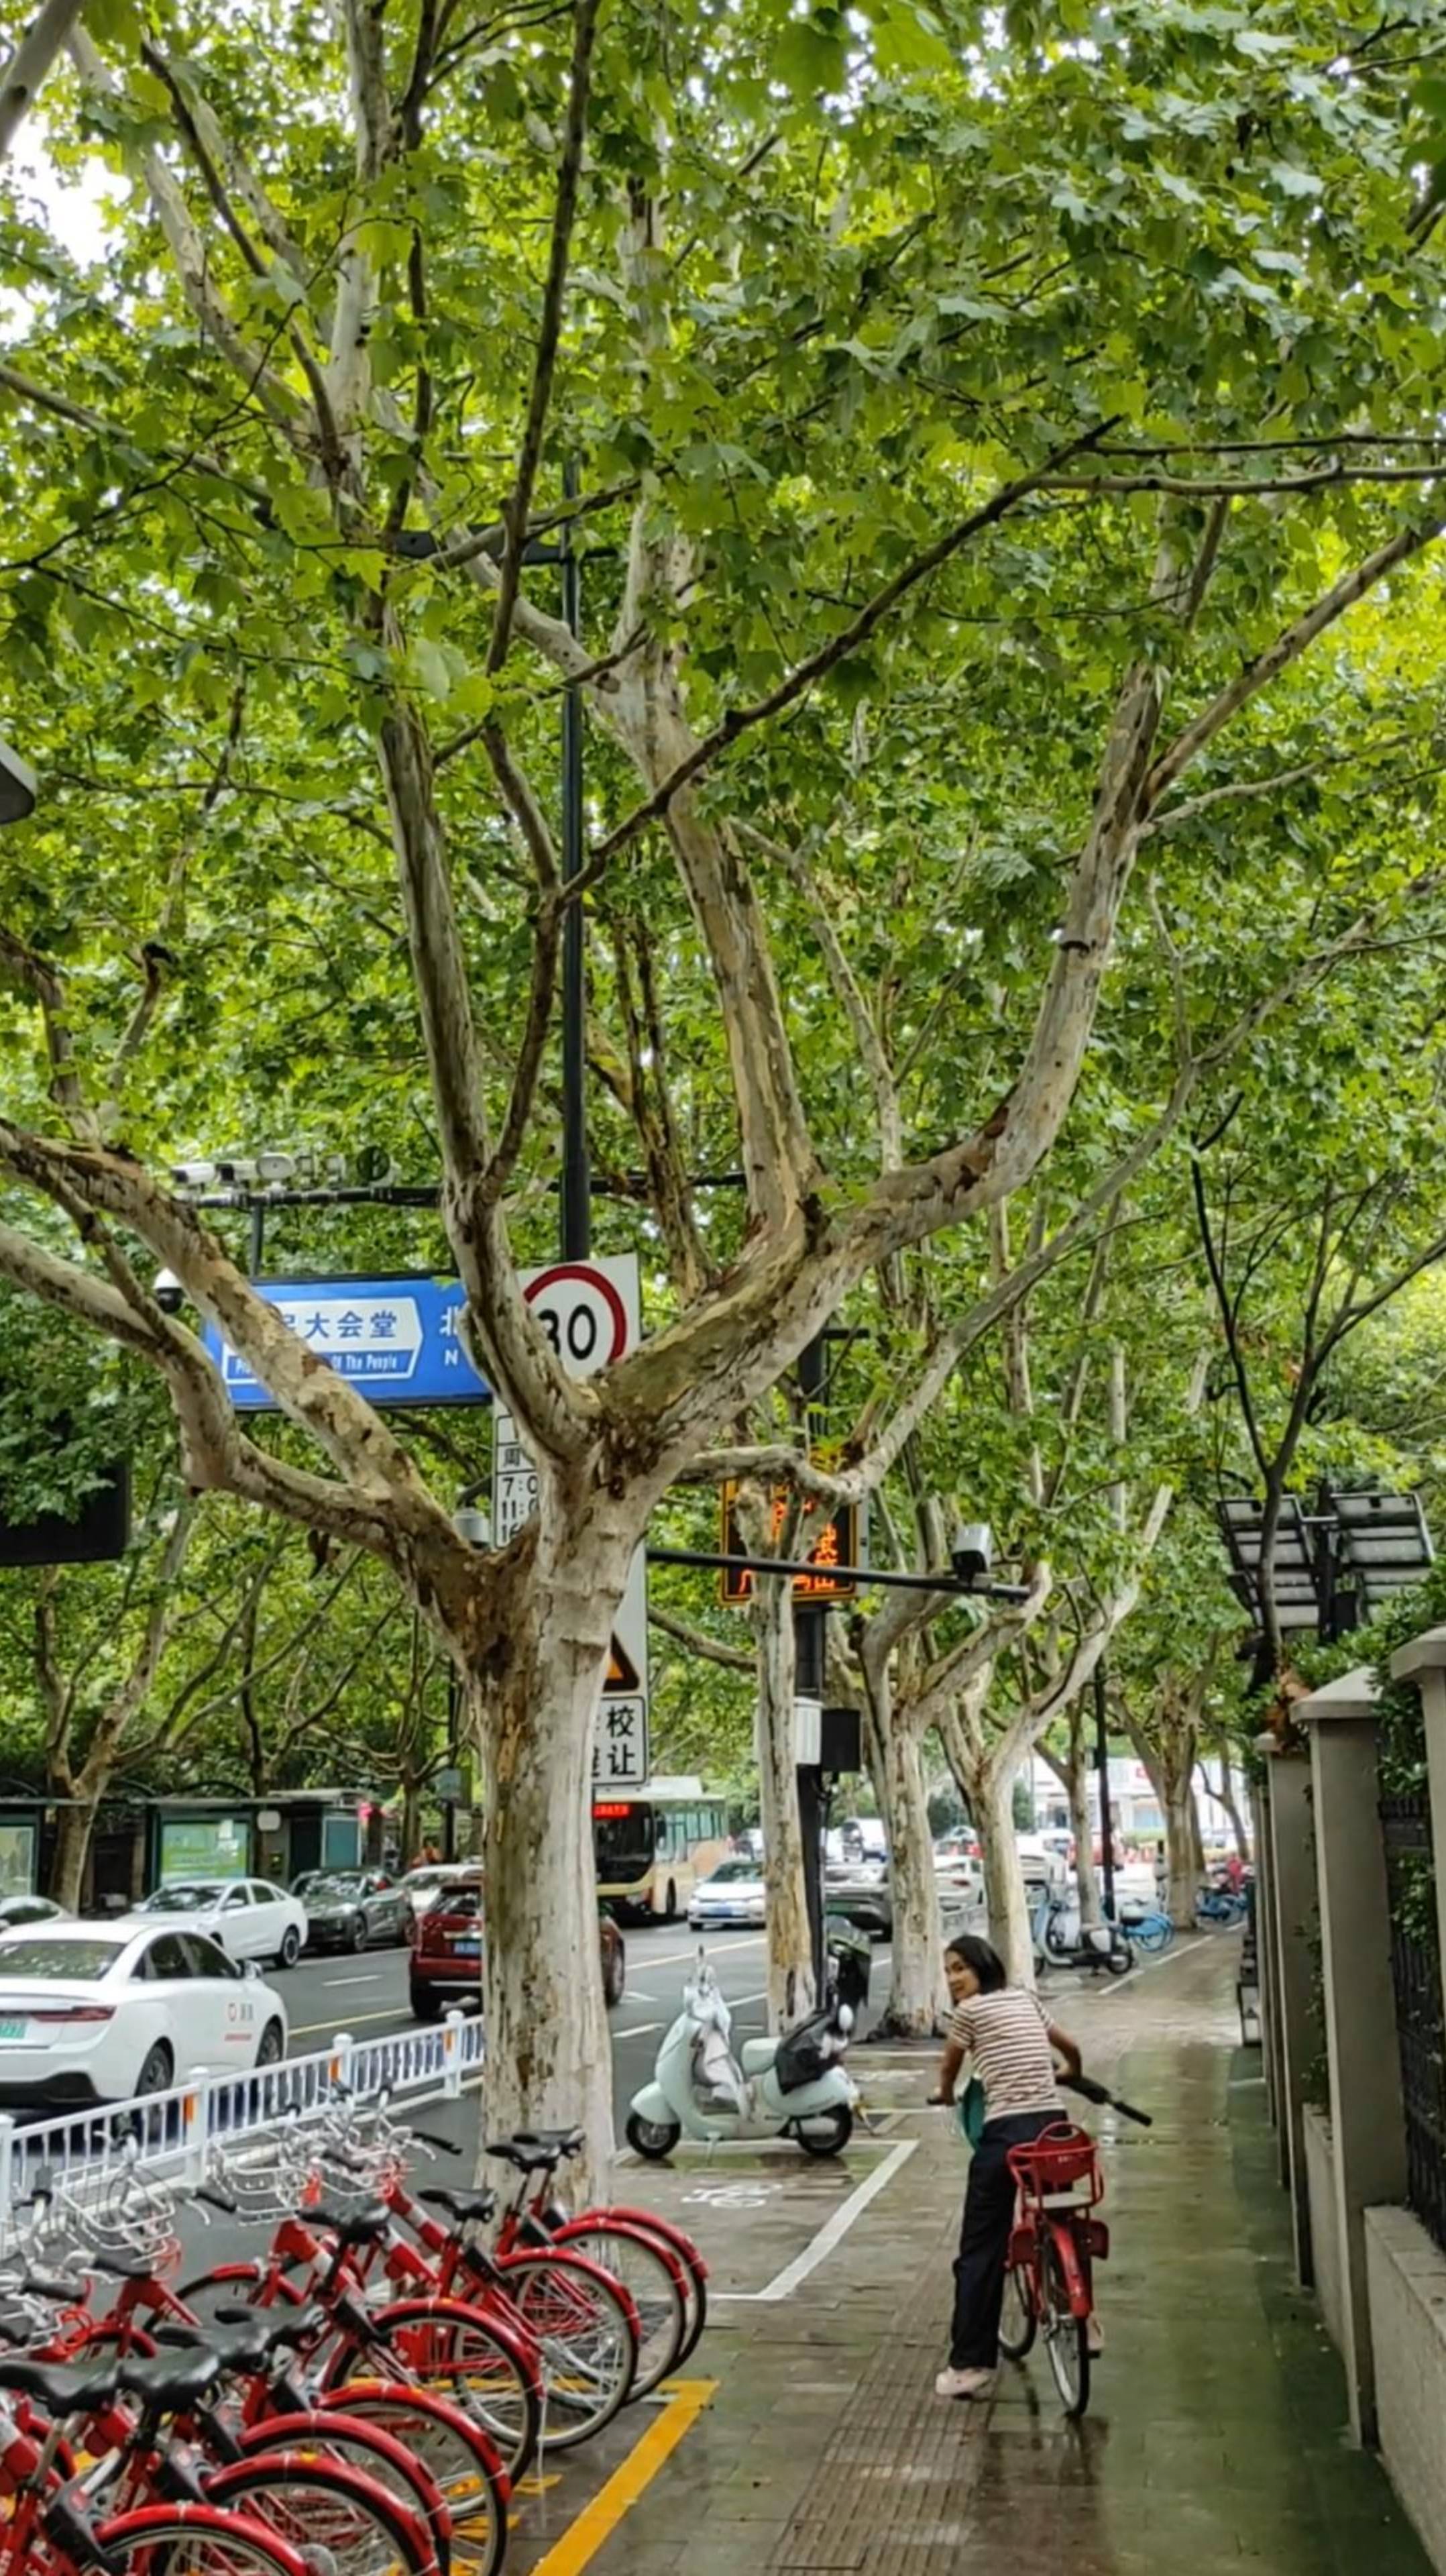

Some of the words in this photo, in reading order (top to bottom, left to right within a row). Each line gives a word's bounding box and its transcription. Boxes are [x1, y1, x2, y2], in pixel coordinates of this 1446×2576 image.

[347, 1354, 363, 1370] The
[366, 1354, 397, 1372] People
[445, 1349, 458, 1366] N
[596, 1705, 634, 1737] 校
